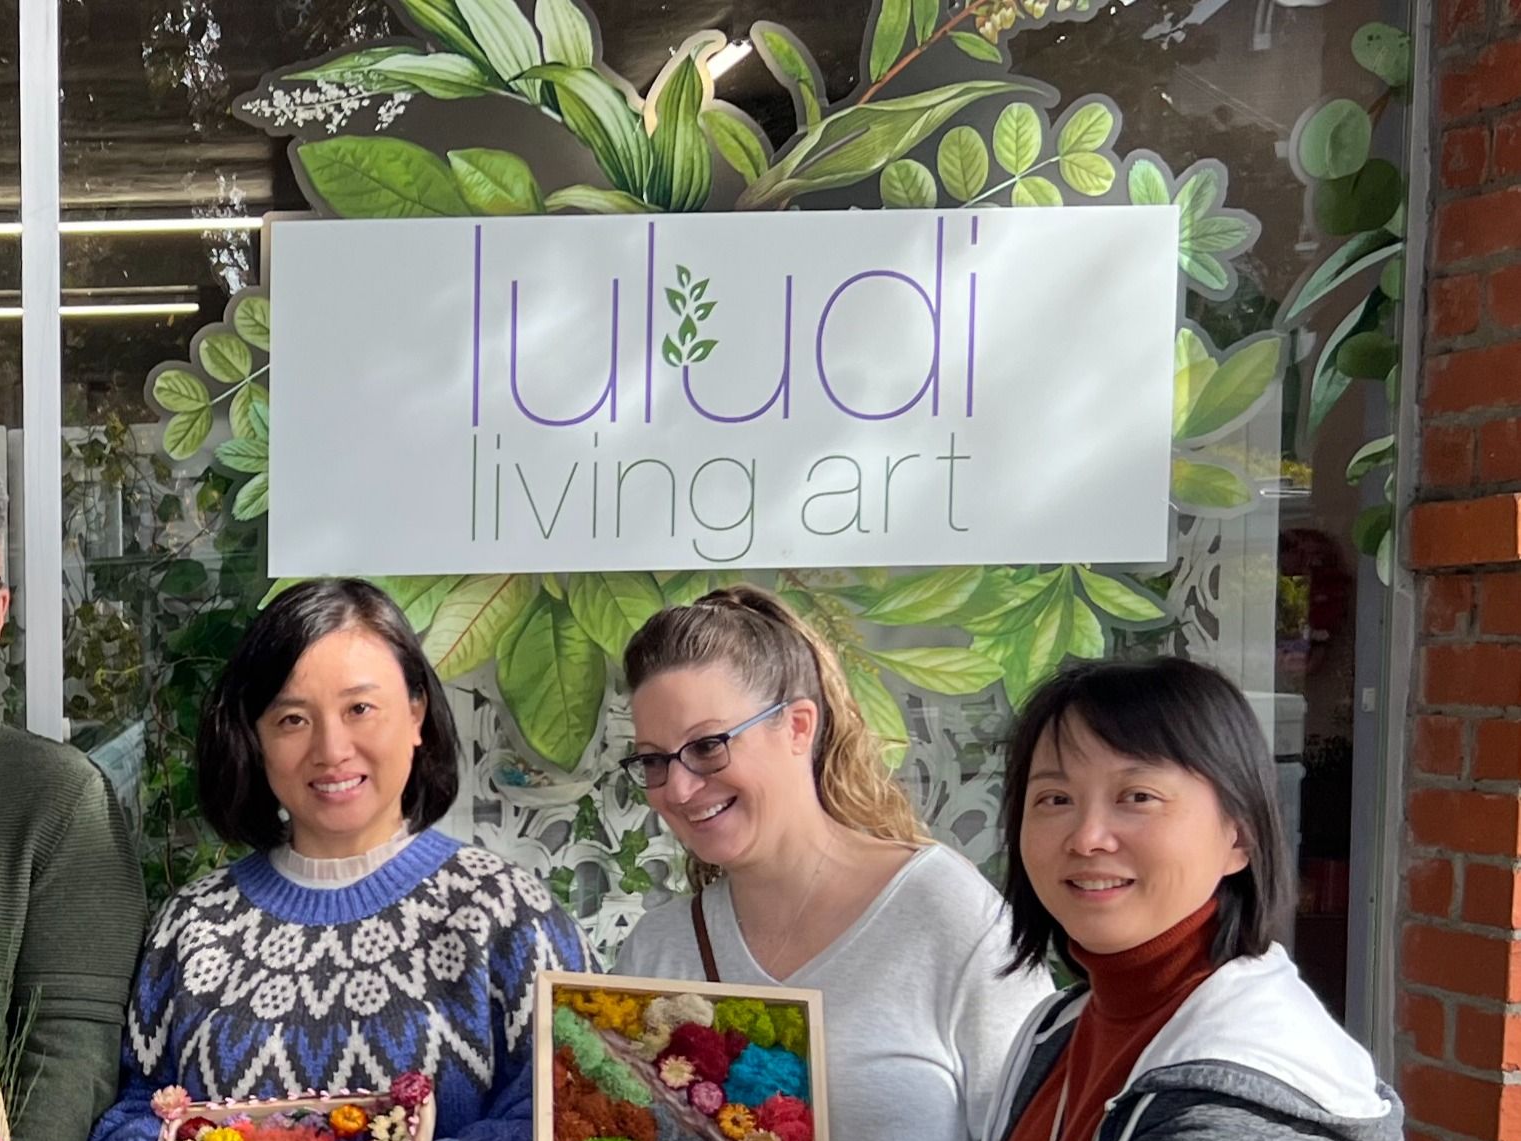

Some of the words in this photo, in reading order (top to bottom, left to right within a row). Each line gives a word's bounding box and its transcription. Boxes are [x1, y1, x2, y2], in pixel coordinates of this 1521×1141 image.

[471, 216, 978, 428] luludi
[471, 432, 757, 563] living
[800, 432, 971, 536] art
